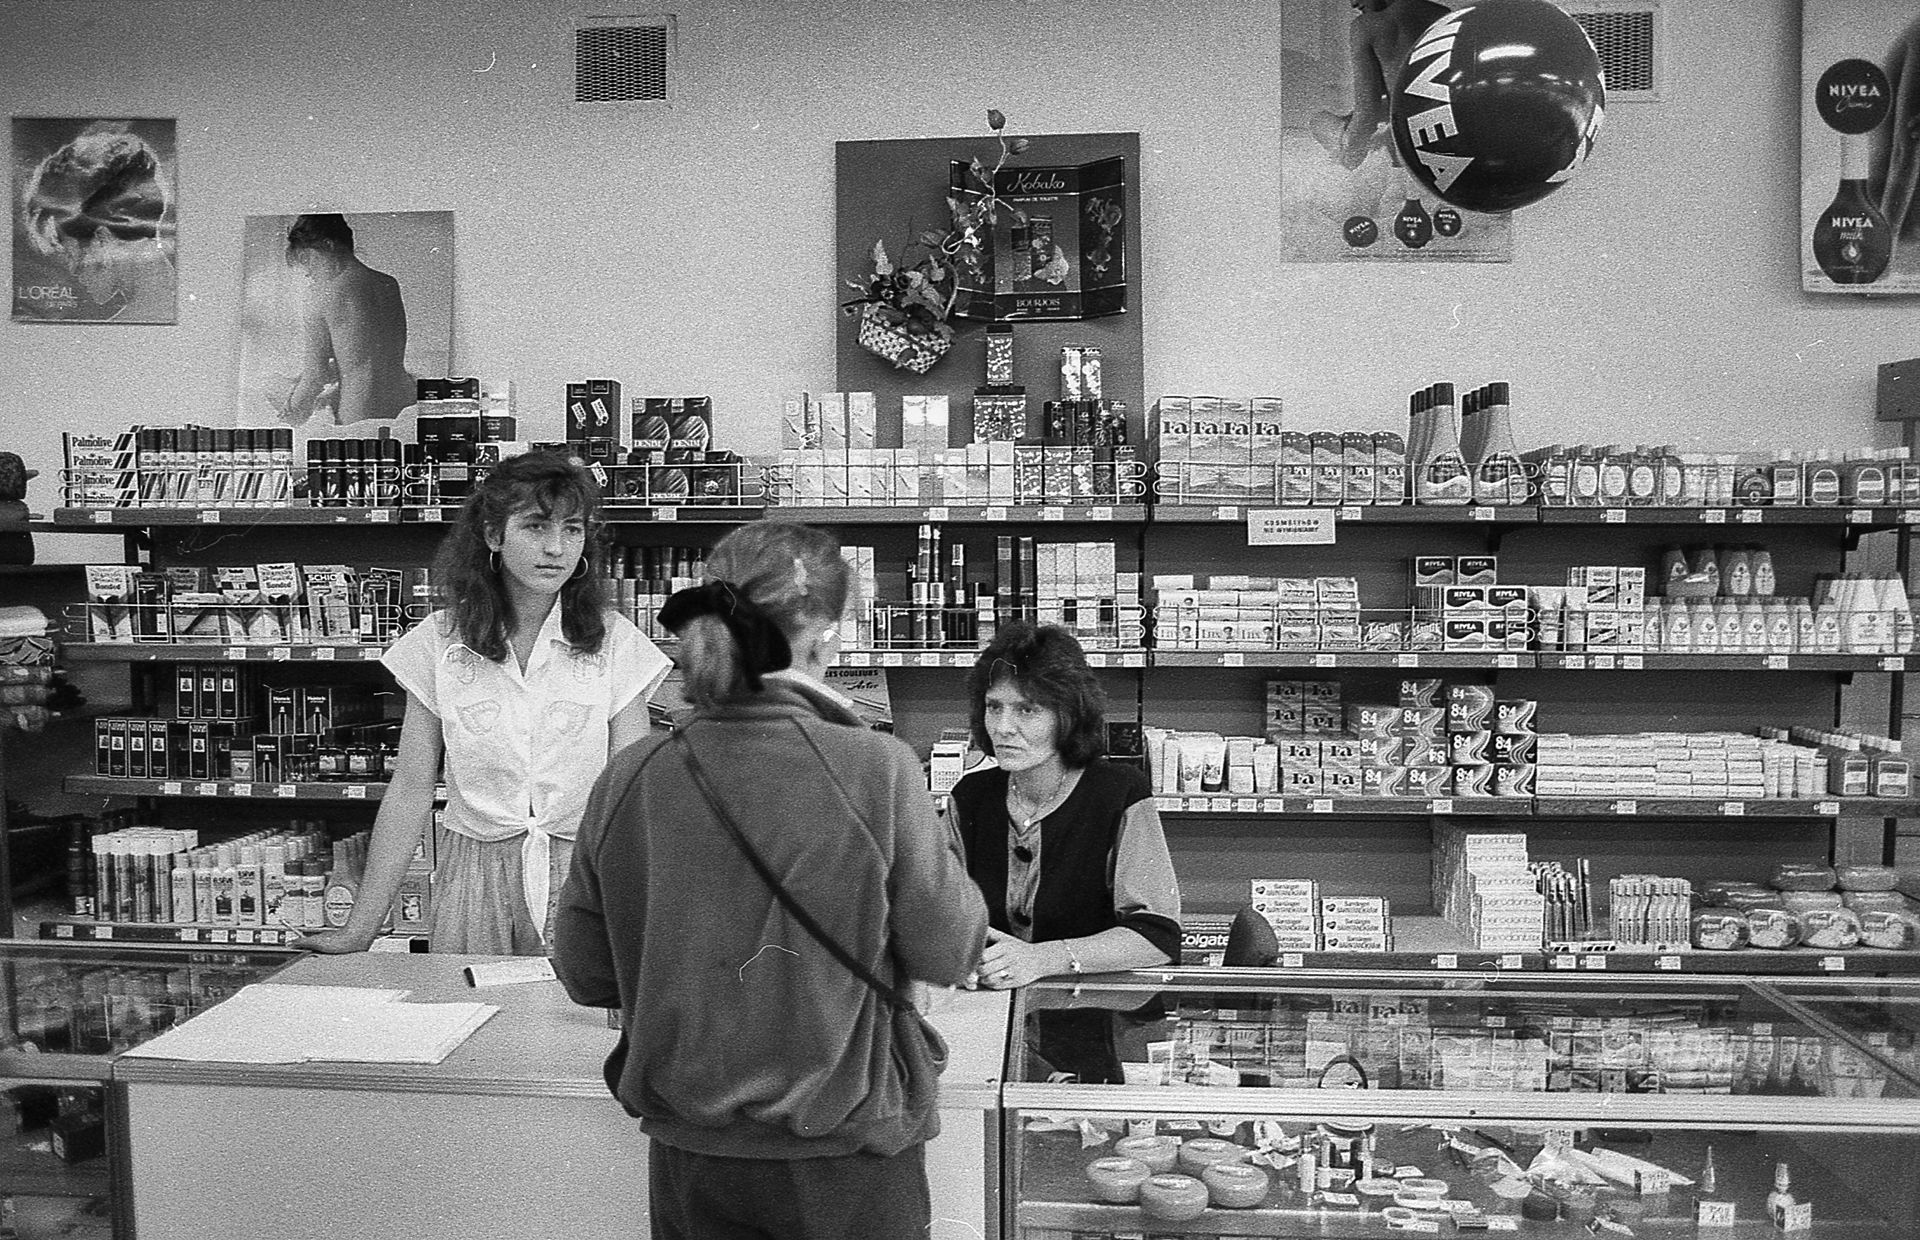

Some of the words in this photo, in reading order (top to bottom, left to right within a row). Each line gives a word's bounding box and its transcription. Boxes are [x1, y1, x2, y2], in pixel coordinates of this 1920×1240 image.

[1829, 84, 1881, 97] NIVEA
[1006, 172, 1065, 194] Kobako
[1832, 217, 1874, 229] NIVEA
[1163, 421, 1188, 435] Fa
[1194, 421, 1219, 435] Fa
[1224, 421, 1249, 435] Fa
[1256, 421, 1281, 436] Fa
[72, 436, 113, 448] Palmolive
[73, 455, 113, 466] Palmolive
[1275, 684, 1297, 696] Fa
[1274, 709, 1297, 721] Fa
[1289, 745, 1312, 757] Fa
[1330, 745, 1353, 757] Fa
[1292, 773, 1315, 785] Fa
[1332, 773, 1355, 785] Fa
